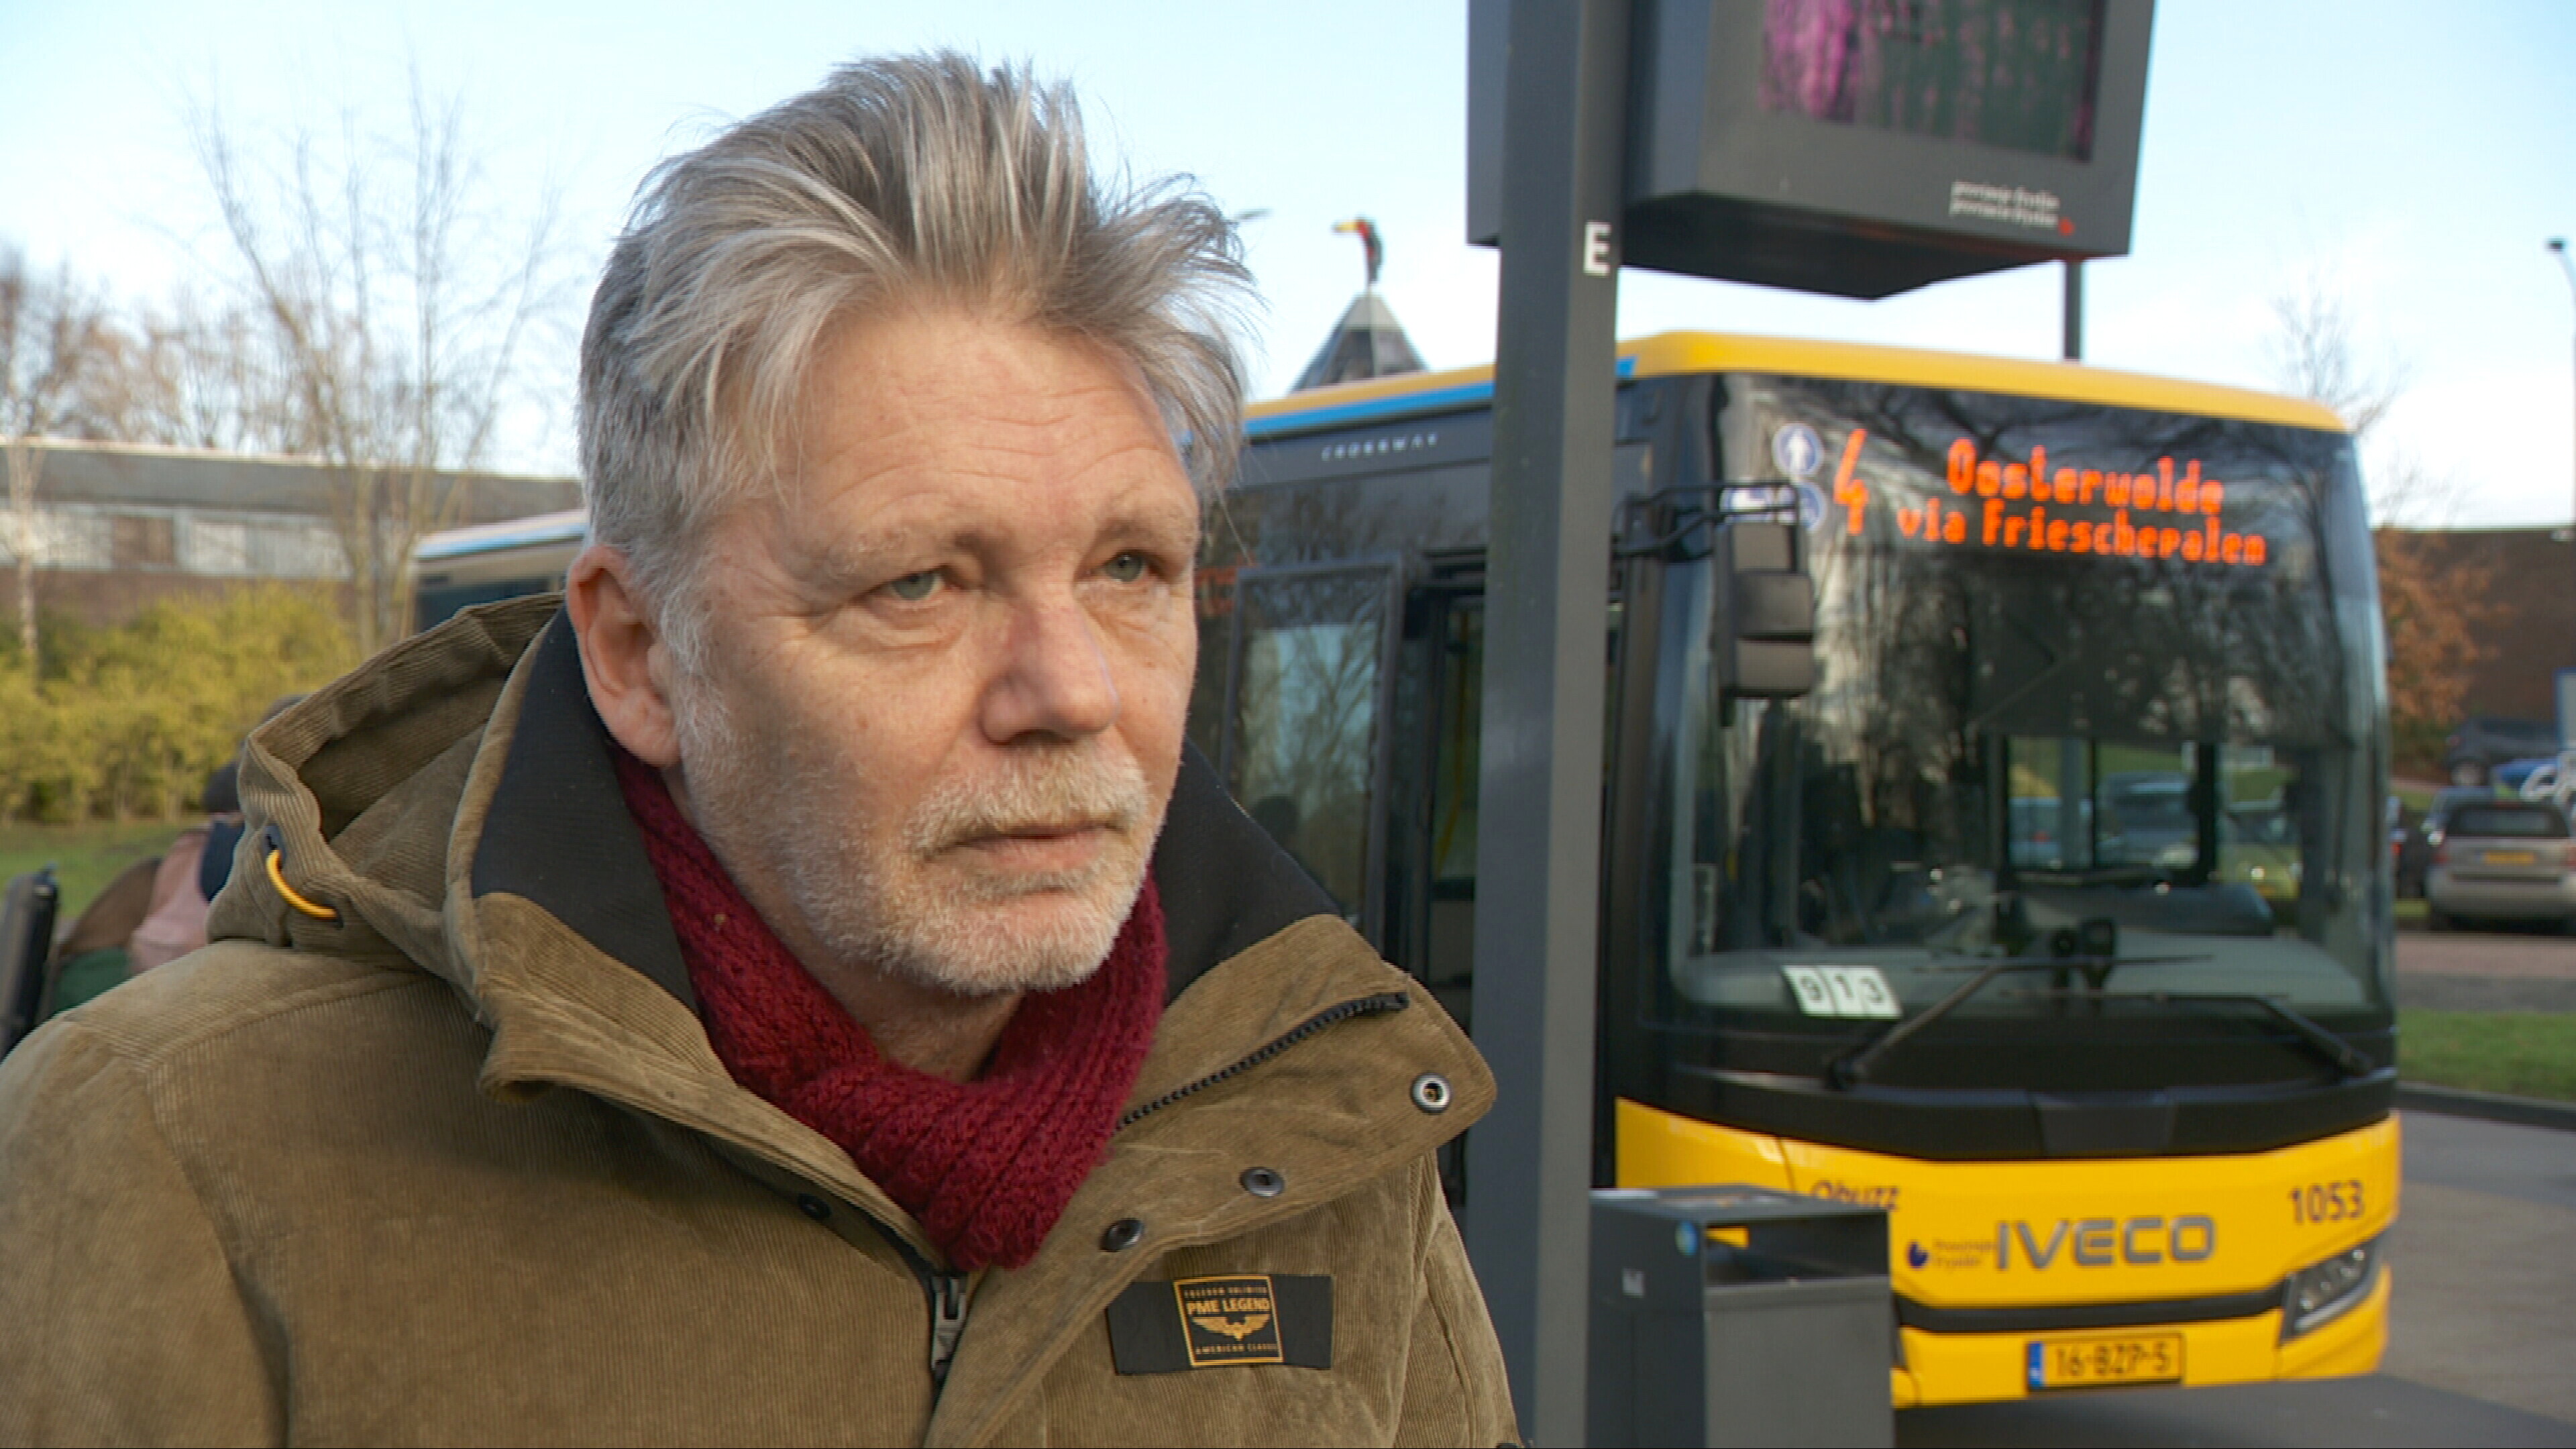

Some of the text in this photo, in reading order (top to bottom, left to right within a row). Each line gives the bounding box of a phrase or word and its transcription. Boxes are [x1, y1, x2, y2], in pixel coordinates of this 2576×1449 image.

[1584, 221, 1611, 276] E
[1833, 428, 1868, 535] 4
[1947, 438, 2224, 516] Oosterwolde
[1897, 496, 1967, 544] via
[2288, 1179, 2365, 1225] 1053
[1996, 1215, 2216, 1272] IVECO
[1186, 1297, 1271, 1316] PME LEGEND
